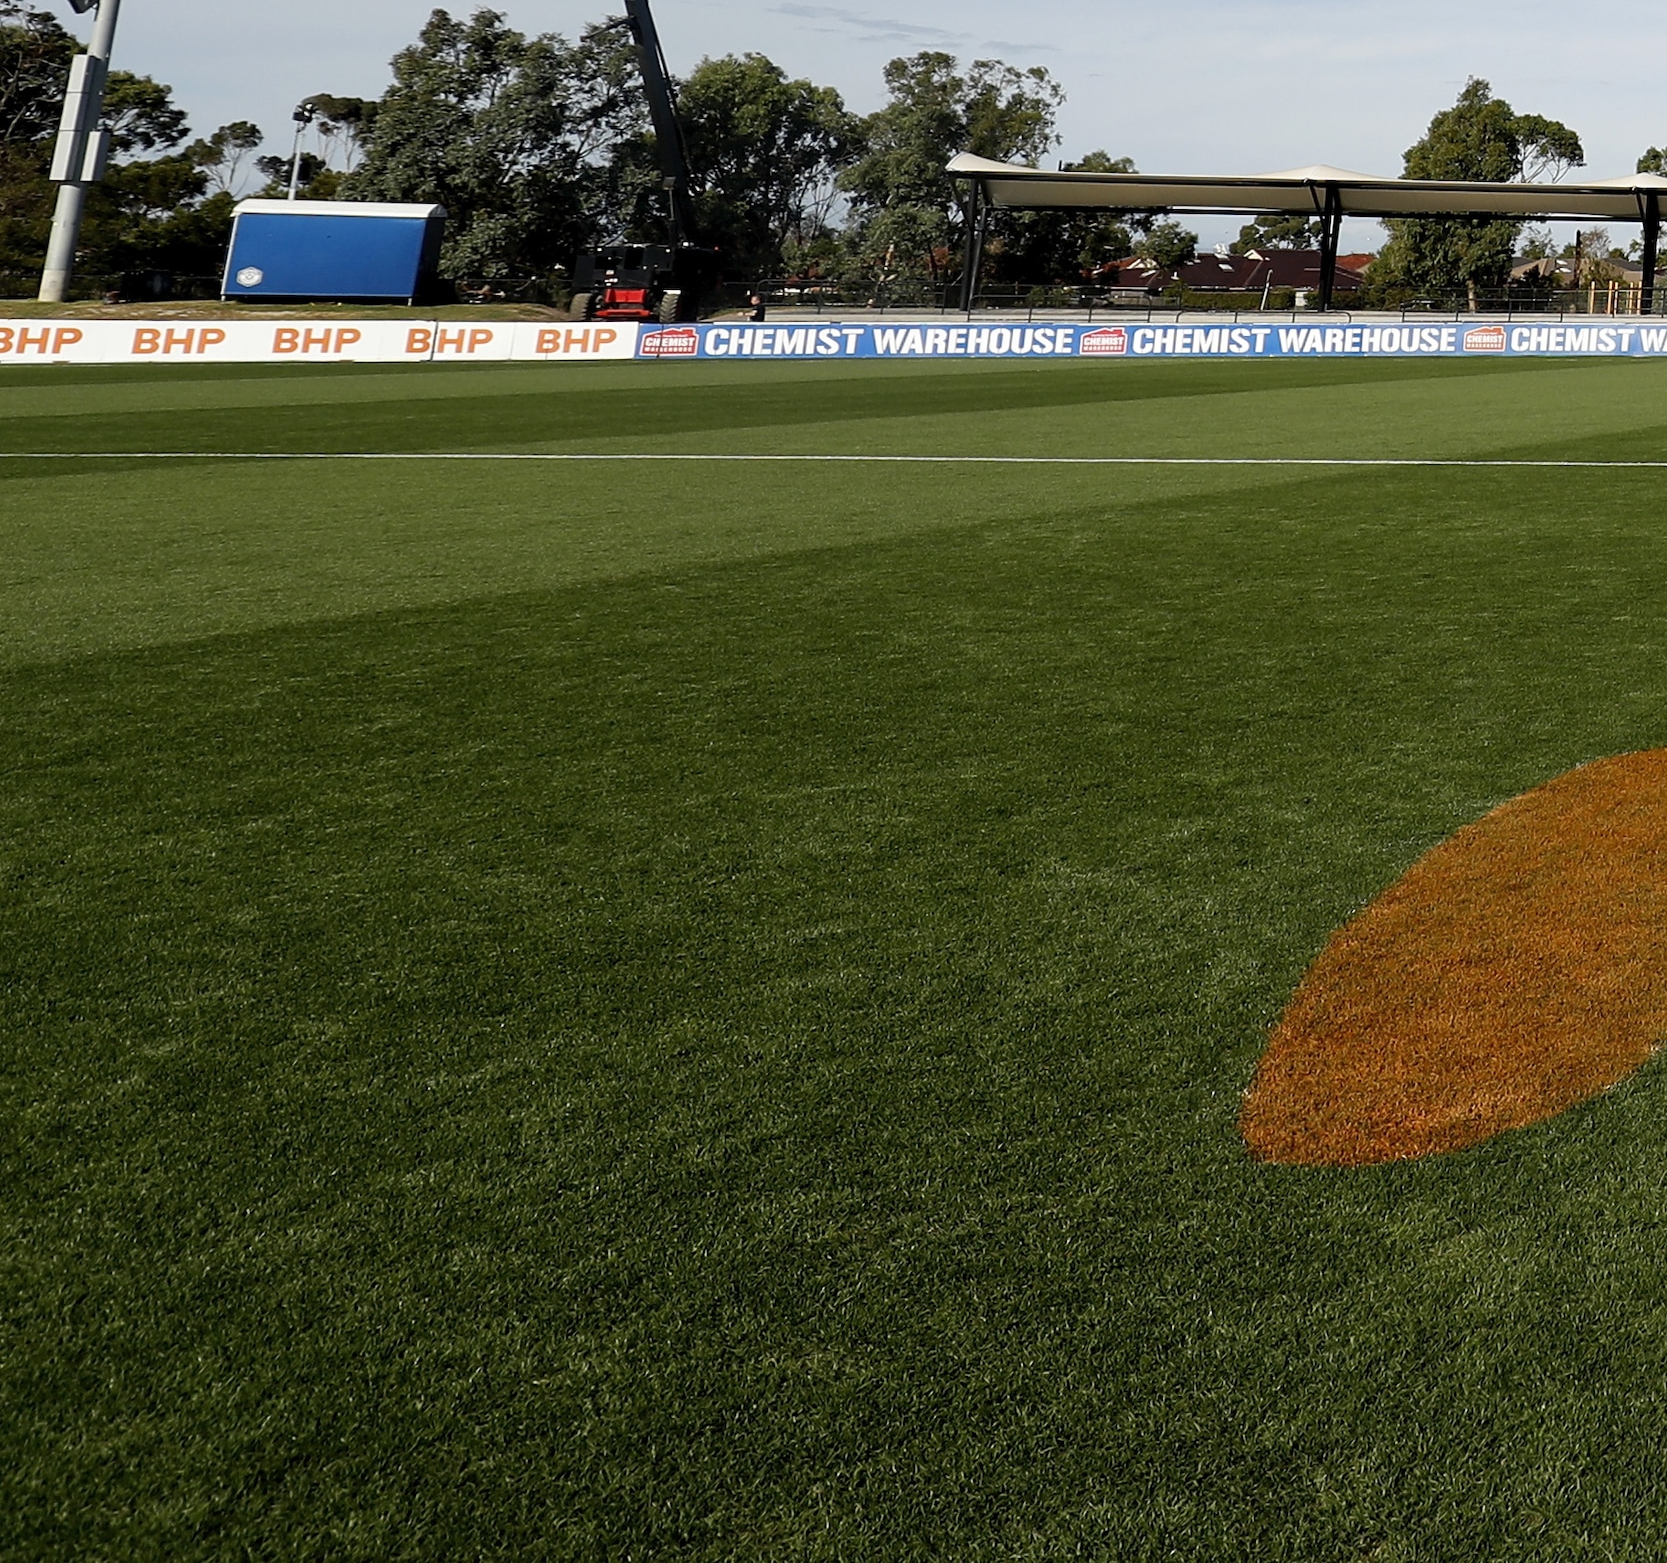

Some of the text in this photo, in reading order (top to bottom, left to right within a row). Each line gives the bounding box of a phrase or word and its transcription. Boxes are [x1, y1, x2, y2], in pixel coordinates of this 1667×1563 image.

[133, 328, 225, 354] BHP
[273, 328, 361, 353] BHP
[405, 328, 493, 353] BHP
[536, 328, 616, 353] BHP
[646, 337, 695, 346] CHEMIST
[704, 328, 1074, 356] CHEMIST WAREHOUSE
[1084, 337, 1124, 345] CHEMIST
[1132, 328, 1457, 354] CHEMIST WAREHOUSE
[1466, 334, 1503, 343] CHEMIST
[1511, 327, 1631, 352] CHEMIST
